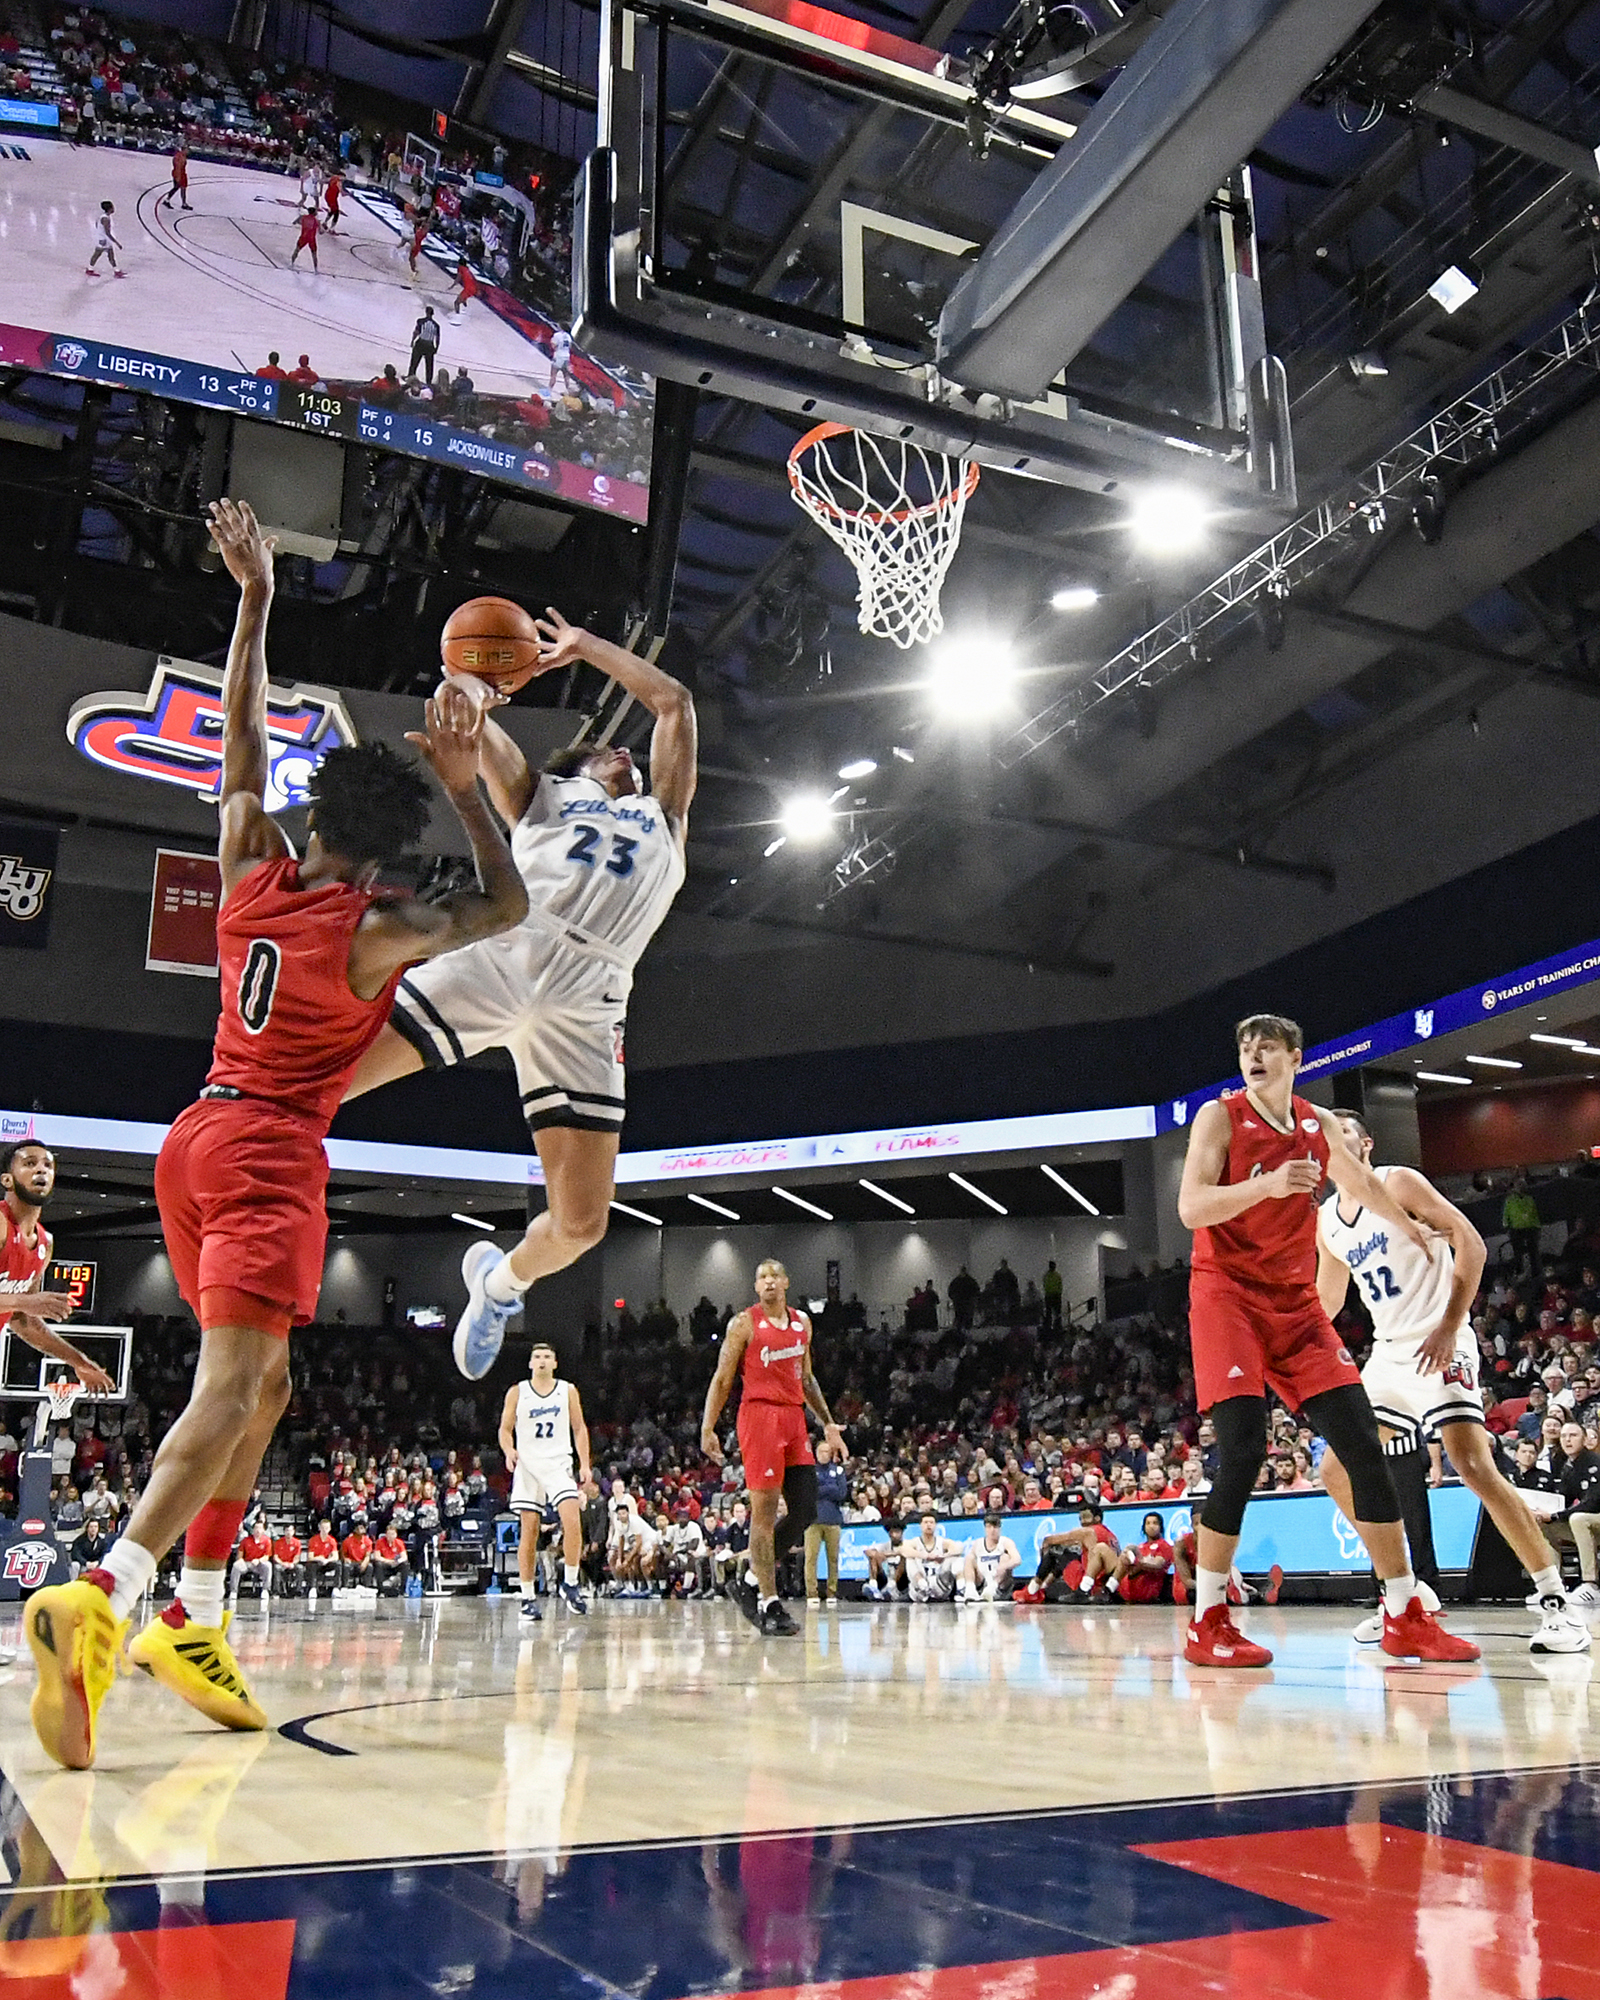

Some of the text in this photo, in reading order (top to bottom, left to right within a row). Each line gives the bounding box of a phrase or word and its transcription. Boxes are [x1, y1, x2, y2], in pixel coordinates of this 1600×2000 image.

[98, 353, 220, 392] LIBERTY 13
[240, 379, 273, 396] PF 0
[238, 394, 271, 411] TO 4
[298, 392, 342, 415] 11:03
[303, 411, 332, 428] 1ST
[361, 409, 393, 426] PF 0
[360, 424, 391, 441] TO 4
[414, 429, 517, 469] 15 JACKSONVILLE ST
[566, 824, 639, 879] 23
[237, 938, 282, 1035] 0
[1497, 984, 1524, 1001] YEARS
[1523, 979, 1536, 992] OF
[1536, 963, 1582, 987] TRAINING
[1331, 1051, 1346, 1062] FOR
[1346, 1040, 1372, 1057] CHRIST
[1346, 1231, 1389, 1269] Liberty
[54, 1266, 91, 1282] 11:03
[1361, 1265, 1403, 1302] 32
[535, 1421, 554, 1438] 22
[5, 1551, 46, 1587] LU
